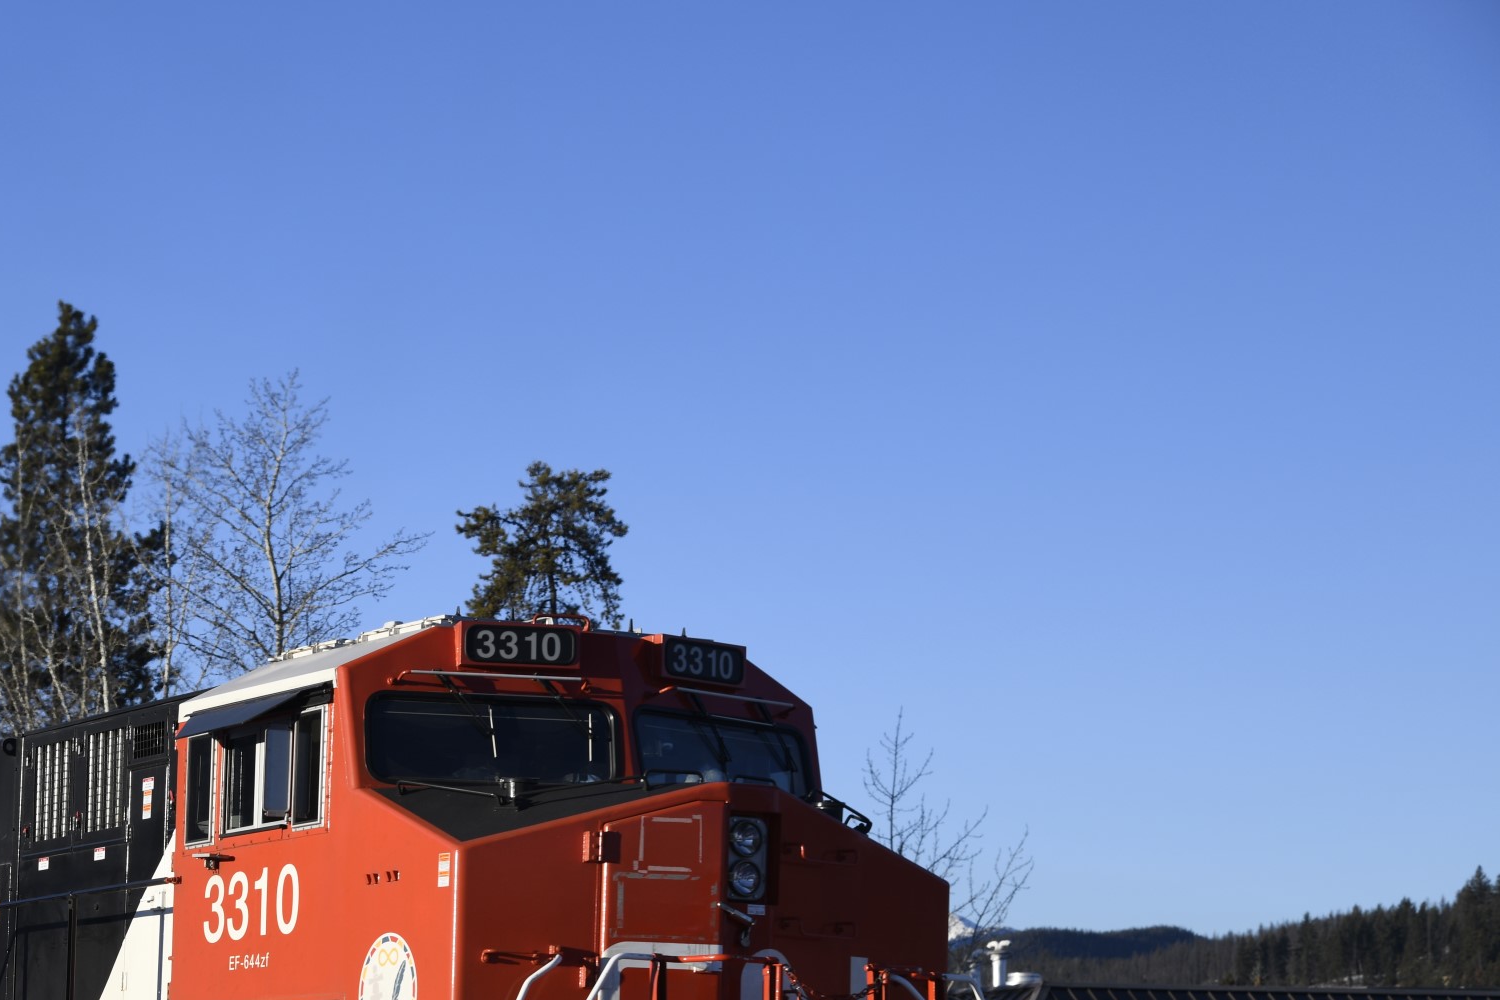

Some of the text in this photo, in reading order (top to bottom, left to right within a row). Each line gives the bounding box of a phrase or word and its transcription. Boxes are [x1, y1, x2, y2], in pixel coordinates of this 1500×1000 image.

[476, 629, 561, 662] 3310
[672, 643, 734, 680] 3310
[202, 863, 300, 944] 3310
[228, 952, 270, 971] EF-644zf
